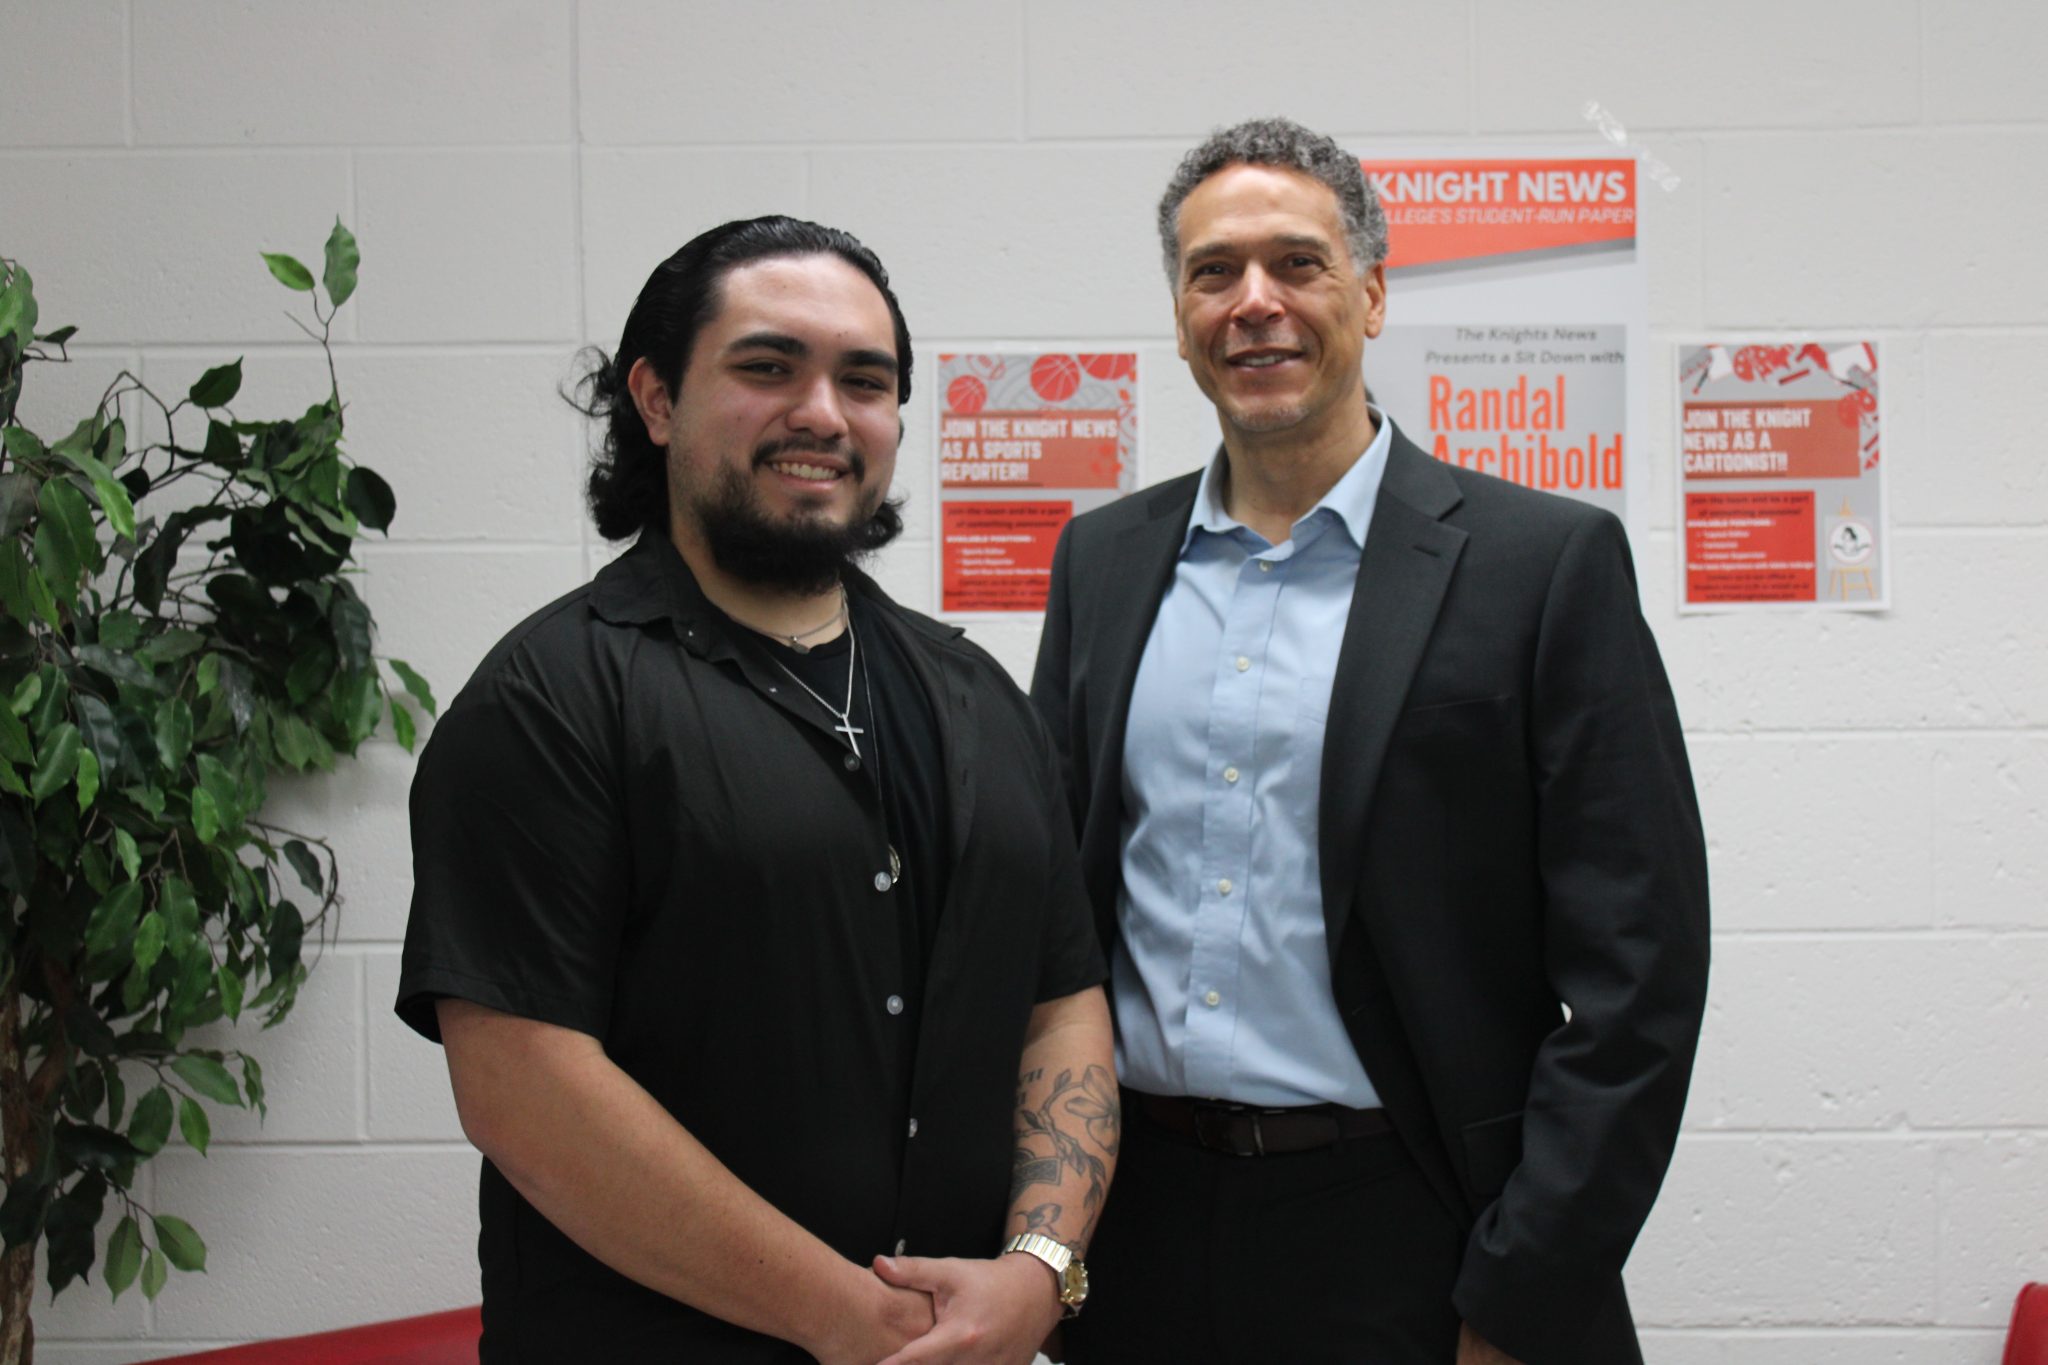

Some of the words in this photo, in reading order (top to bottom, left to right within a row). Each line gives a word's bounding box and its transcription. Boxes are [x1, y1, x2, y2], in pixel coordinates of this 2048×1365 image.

[1369, 171, 1509, 203] KNIGHT
[1518, 171, 1626, 203] NEWS
[1383, 208, 1452, 224] LLEGE'S
[1456, 328, 1484, 341] The
[1488, 328, 1547, 344] Knights
[1553, 328, 1597, 341] News
[1425, 351, 1496, 364] Presents
[1501, 354, 1510, 363] a
[1515, 350, 1536, 363] Sit
[1540, 350, 1586, 363] Down
[1590, 350, 1625, 363] with
[1429, 374, 1565, 432] Randal
[1684, 410, 1718, 429] JOIN
[1722, 409, 1751, 428] THE
[1755, 408, 1812, 428] KNIGHT
[942, 420, 976, 438] JOIN
[980, 420, 1008, 438] THE
[1012, 420, 1068, 438] KNIGHT
[1071, 420, 1118, 438] NEWS
[1684, 431, 1729, 450] NEWS
[1733, 431, 1756, 450] AS
[1759, 430, 1772, 449] A
[942, 441, 963, 460] AS
[967, 441, 979, 459] A
[983, 441, 1042, 459] SPORTS
[1432, 433, 1623, 490] Archibold
